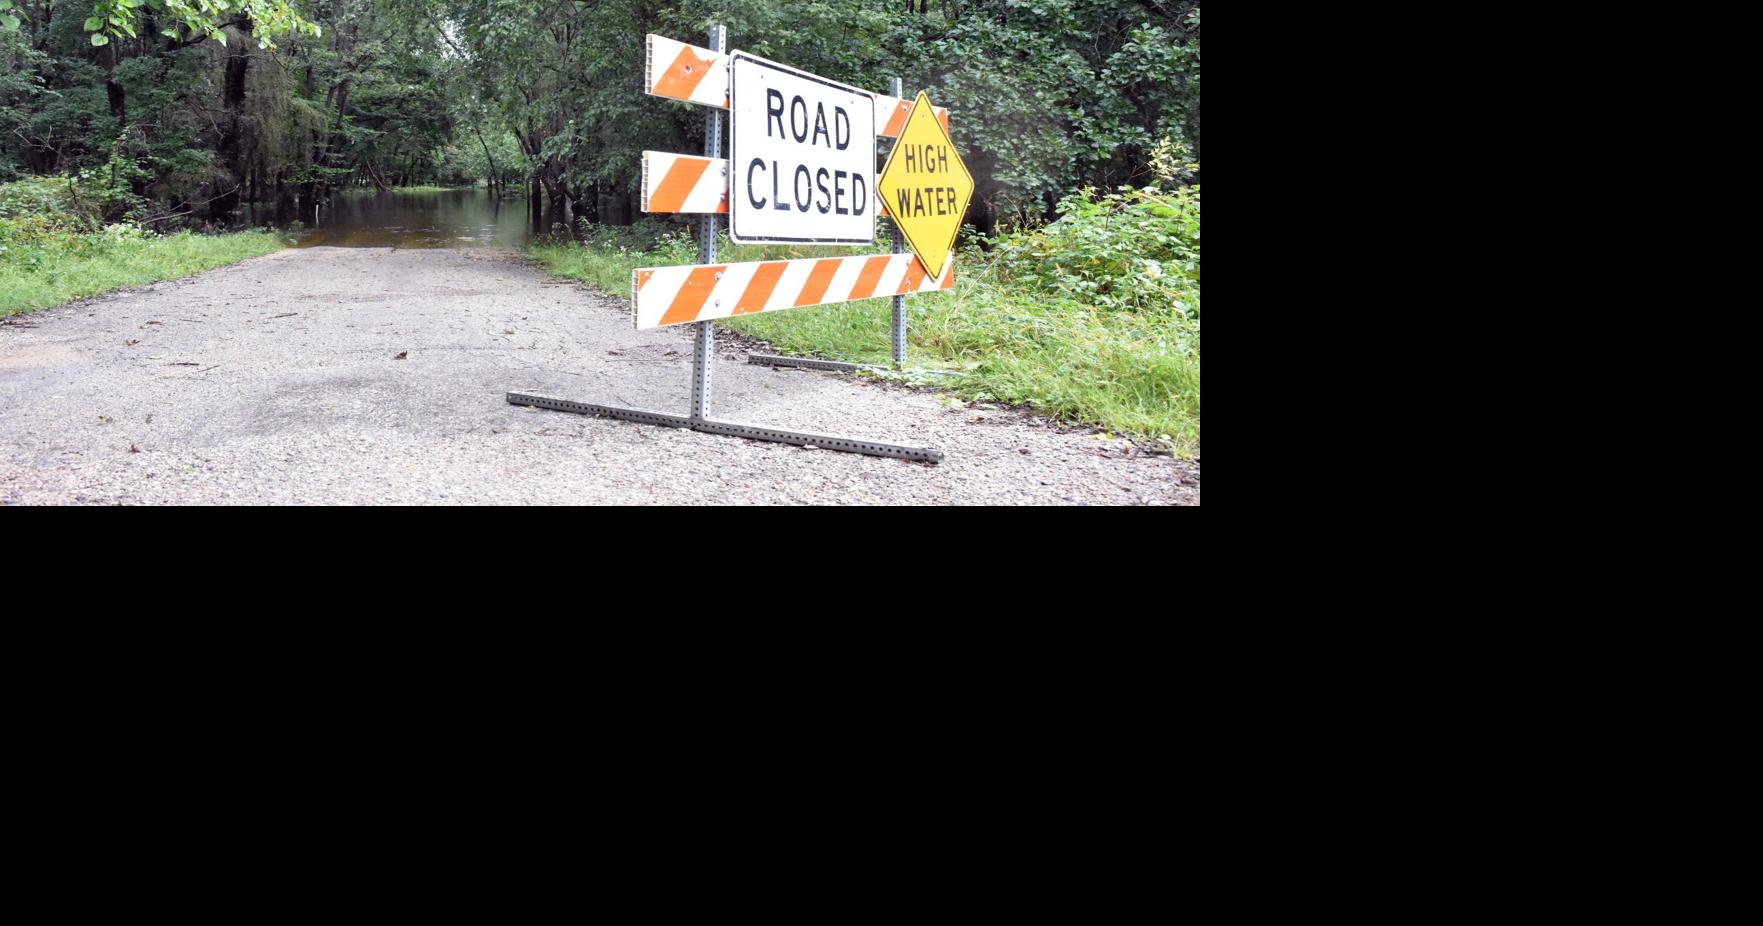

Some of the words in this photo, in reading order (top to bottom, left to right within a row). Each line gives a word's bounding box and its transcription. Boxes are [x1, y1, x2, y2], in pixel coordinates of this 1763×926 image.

[766, 87, 850, 151] ROAD
[905, 143, 948, 174] HIGH
[747, 157, 867, 216] CLOSED
[896, 187, 958, 218] WATER
